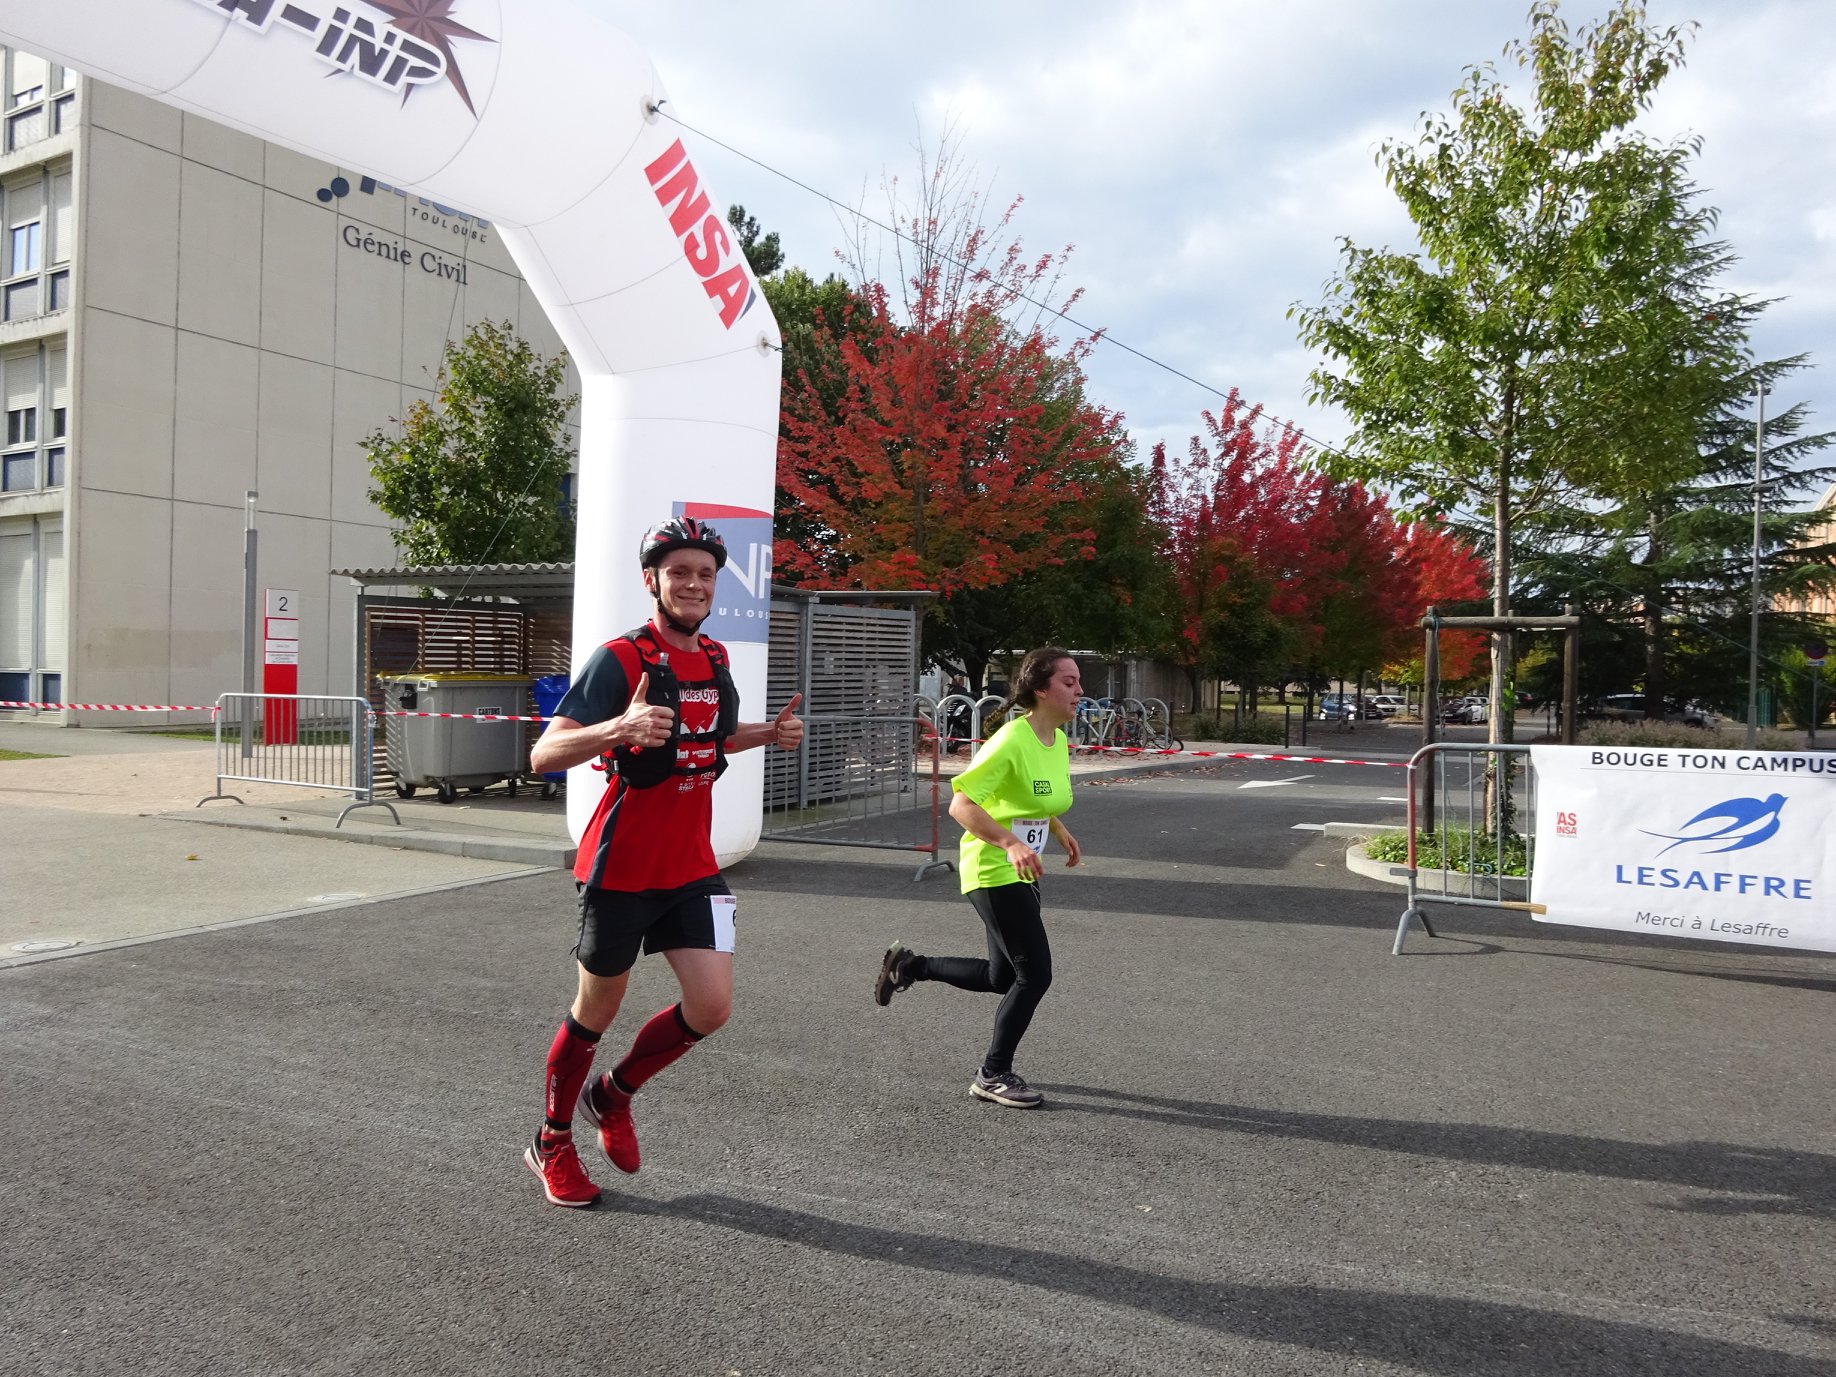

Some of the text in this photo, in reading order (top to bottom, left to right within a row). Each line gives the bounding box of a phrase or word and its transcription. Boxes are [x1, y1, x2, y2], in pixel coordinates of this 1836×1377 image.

[411, 207, 487, 243] TOULOUSE
[643, 136, 751, 331] INSA
[342, 225, 469, 286] Génie Civil
[279, 596, 289, 612] 2
[1591, 751, 1836, 774] BOUGE TON CAMPUS
[1556, 825, 1577, 835] INSA
[1557, 811, 1577, 827] AS
[1027, 828, 1043, 844] 61
[1615, 864, 1813, 900] LESAFFRE
[1635, 911, 1790, 939] Merci à Lesaffre
